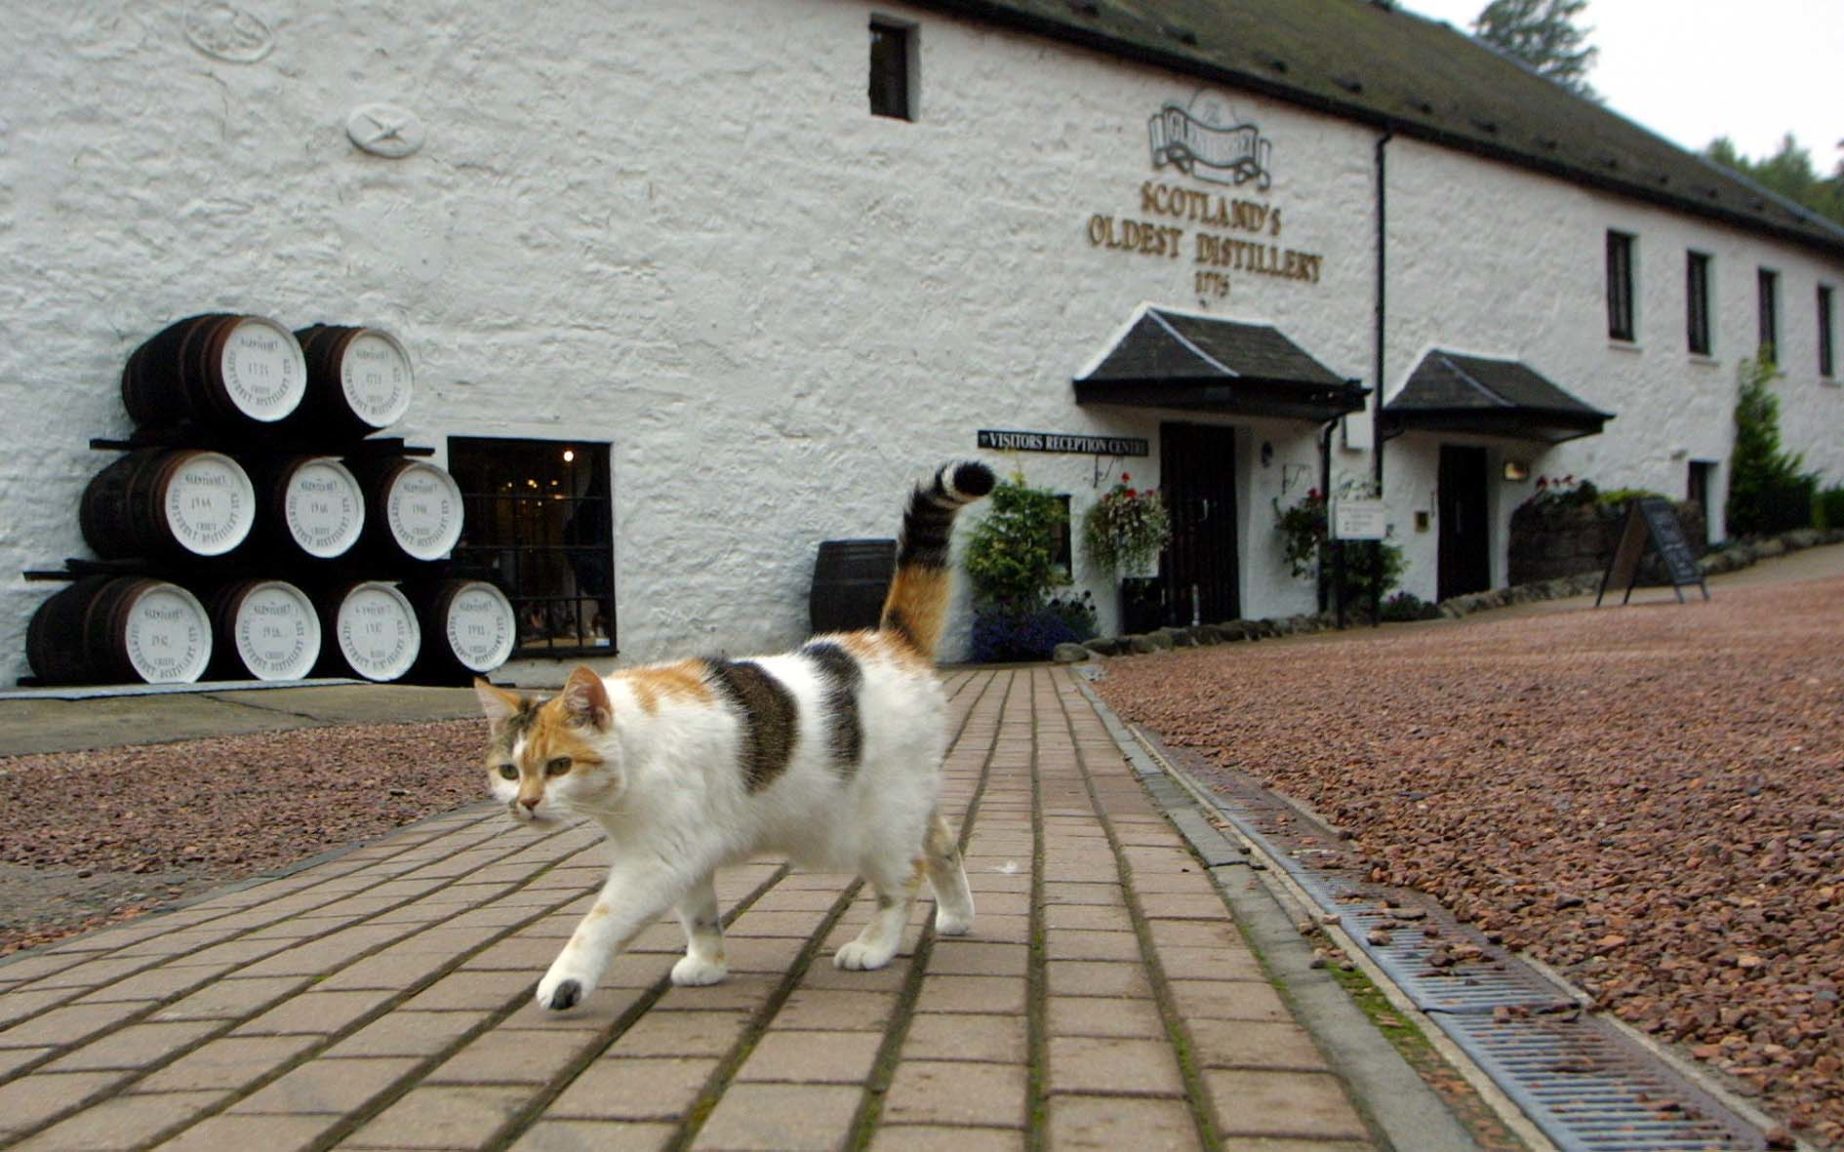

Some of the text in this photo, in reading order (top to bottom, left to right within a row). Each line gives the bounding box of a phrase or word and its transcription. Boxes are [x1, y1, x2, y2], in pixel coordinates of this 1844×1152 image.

[1141, 182, 1281, 236] SCOTLAND'S
[1088, 215, 1322, 283] OLDEST DISTILLERY
[988, 431, 1043, 450] VISITORS
[1047, 434, 1107, 454] RECEPTION
